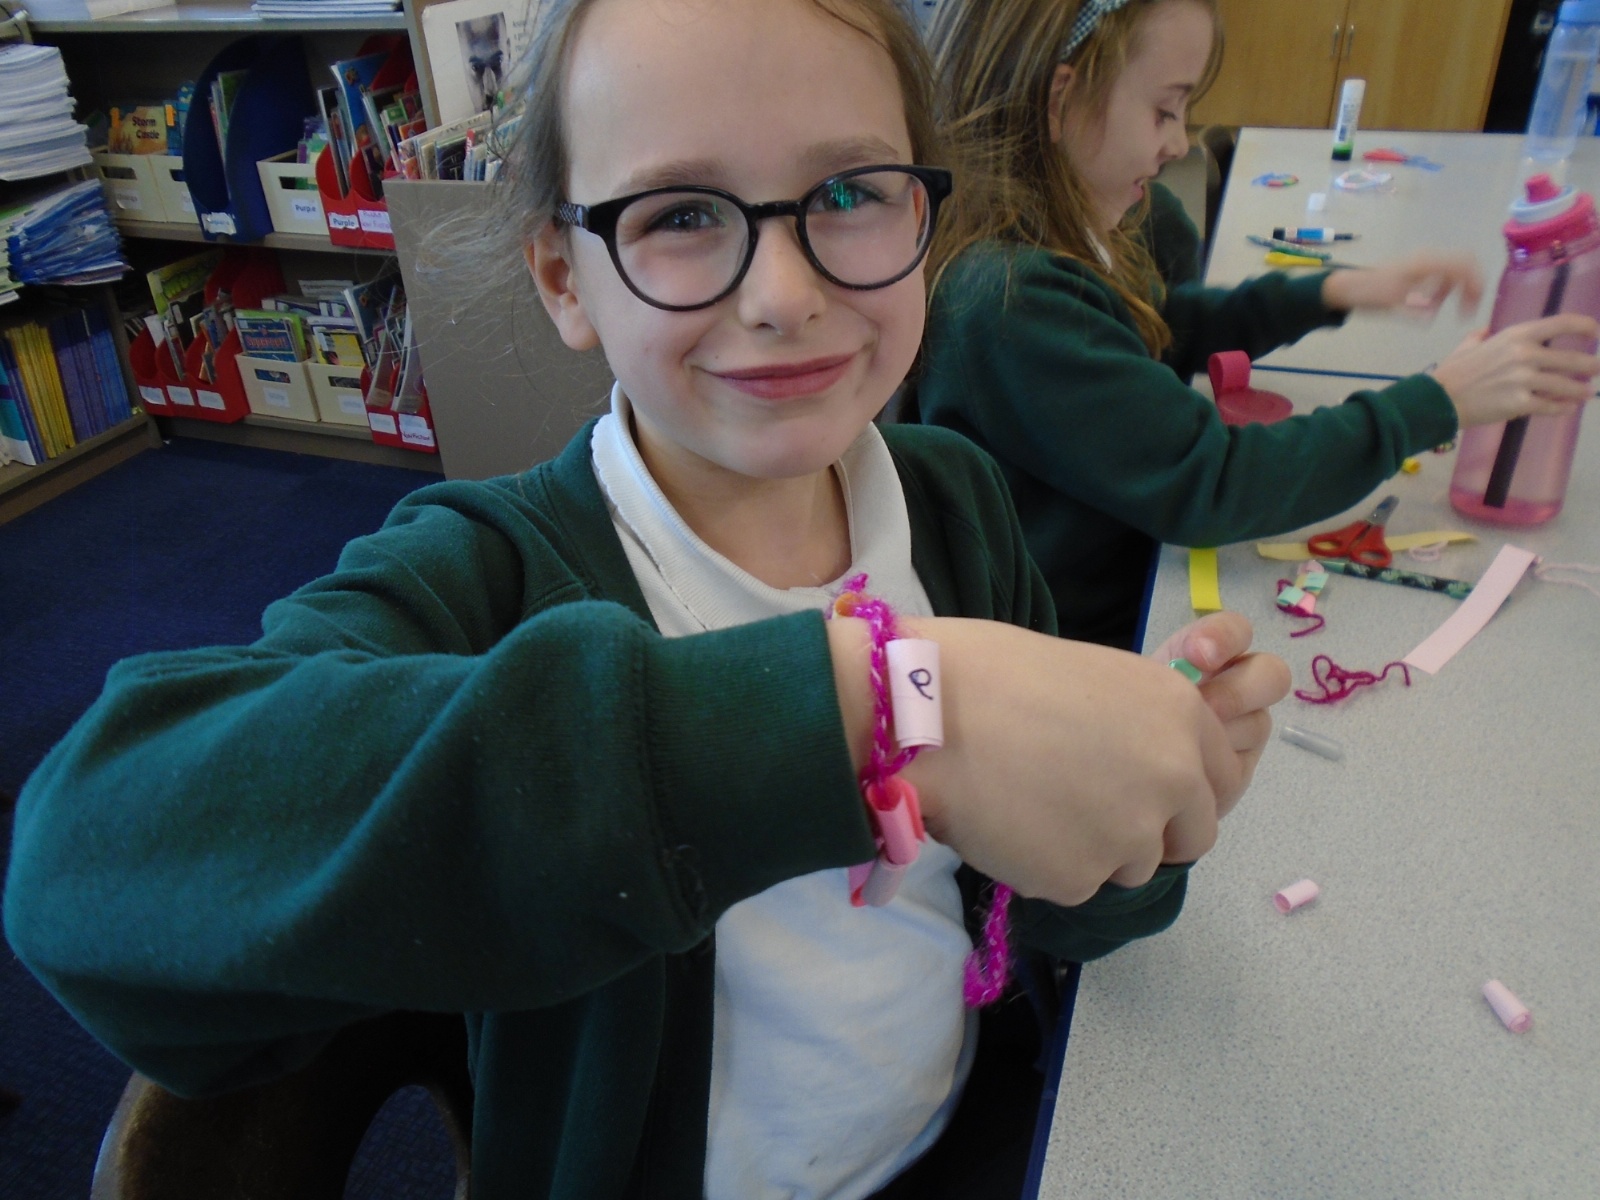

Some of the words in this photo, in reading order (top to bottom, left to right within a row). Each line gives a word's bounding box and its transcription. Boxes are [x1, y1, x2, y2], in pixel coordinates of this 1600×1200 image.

[132, 116, 156, 126] Storm
[136, 128, 160, 139] Castle
[333, 218, 355, 227] Purple
